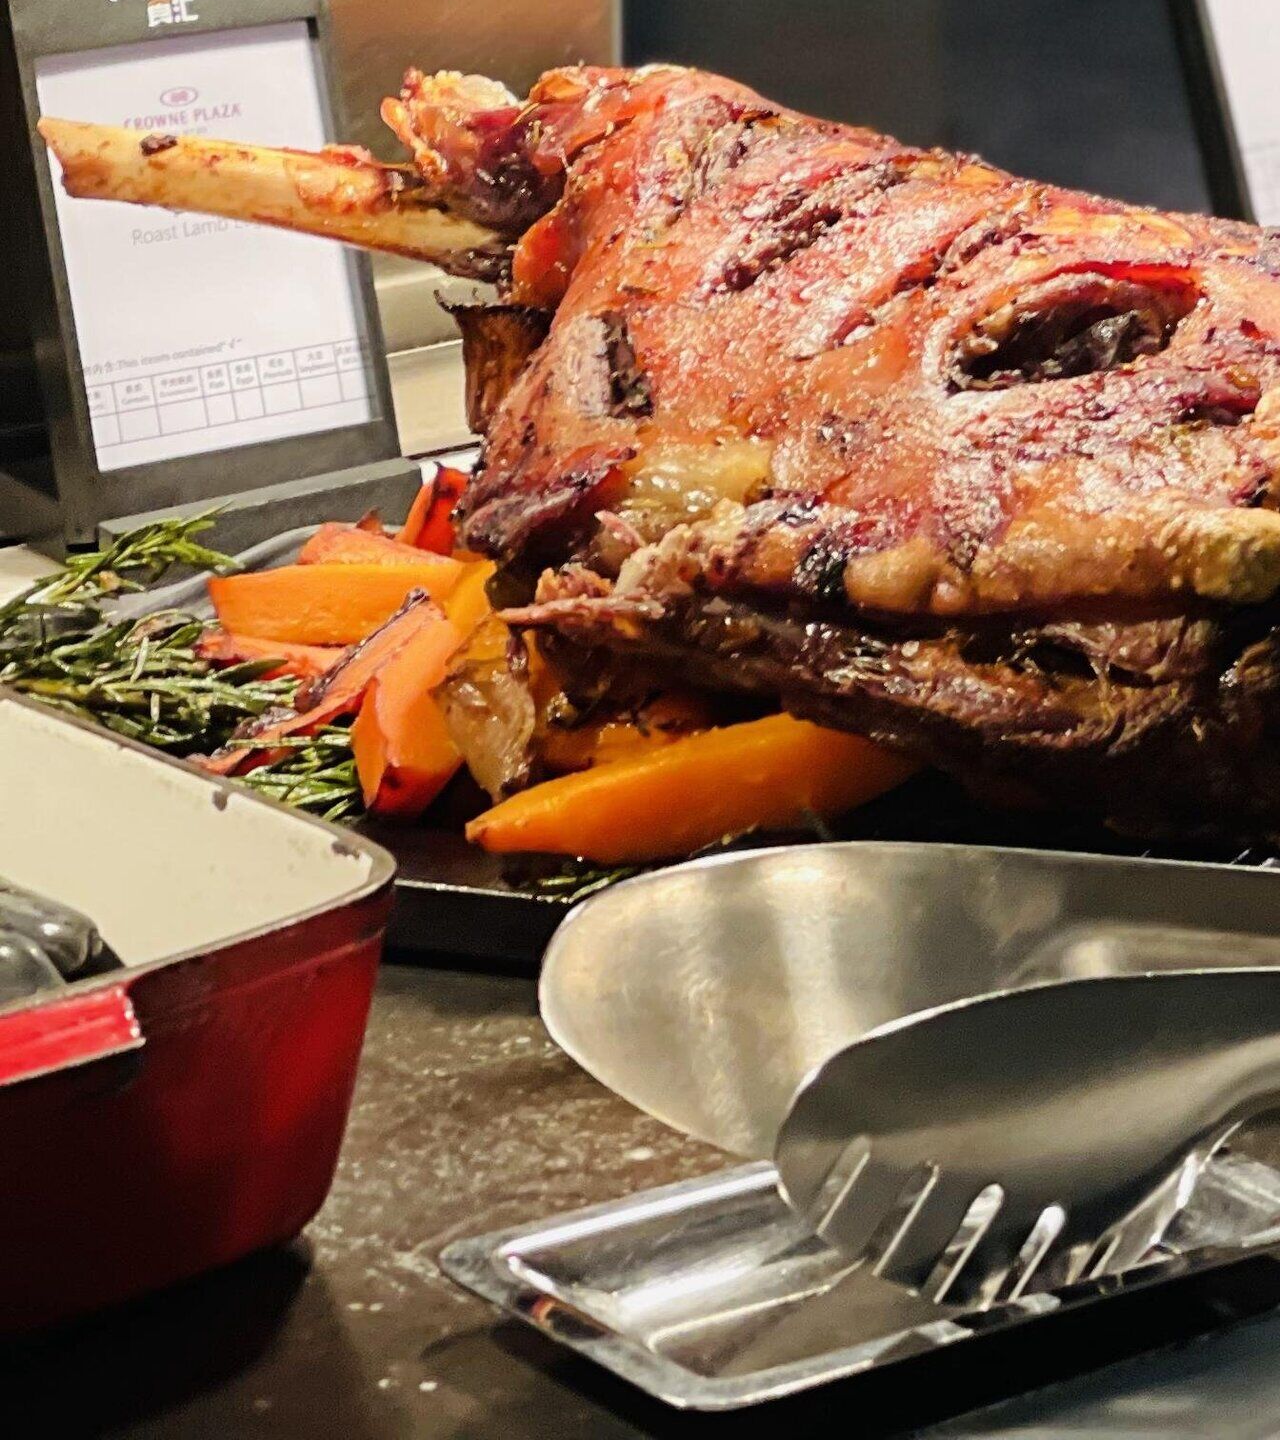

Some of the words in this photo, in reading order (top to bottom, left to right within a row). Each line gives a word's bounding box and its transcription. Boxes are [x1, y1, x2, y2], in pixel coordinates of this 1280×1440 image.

[123, 110, 187, 131] CROWNE
[194, 102, 242, 122] PLAZA
[130, 225, 178, 251] Roast
[182, 220, 228, 238] Lamb
